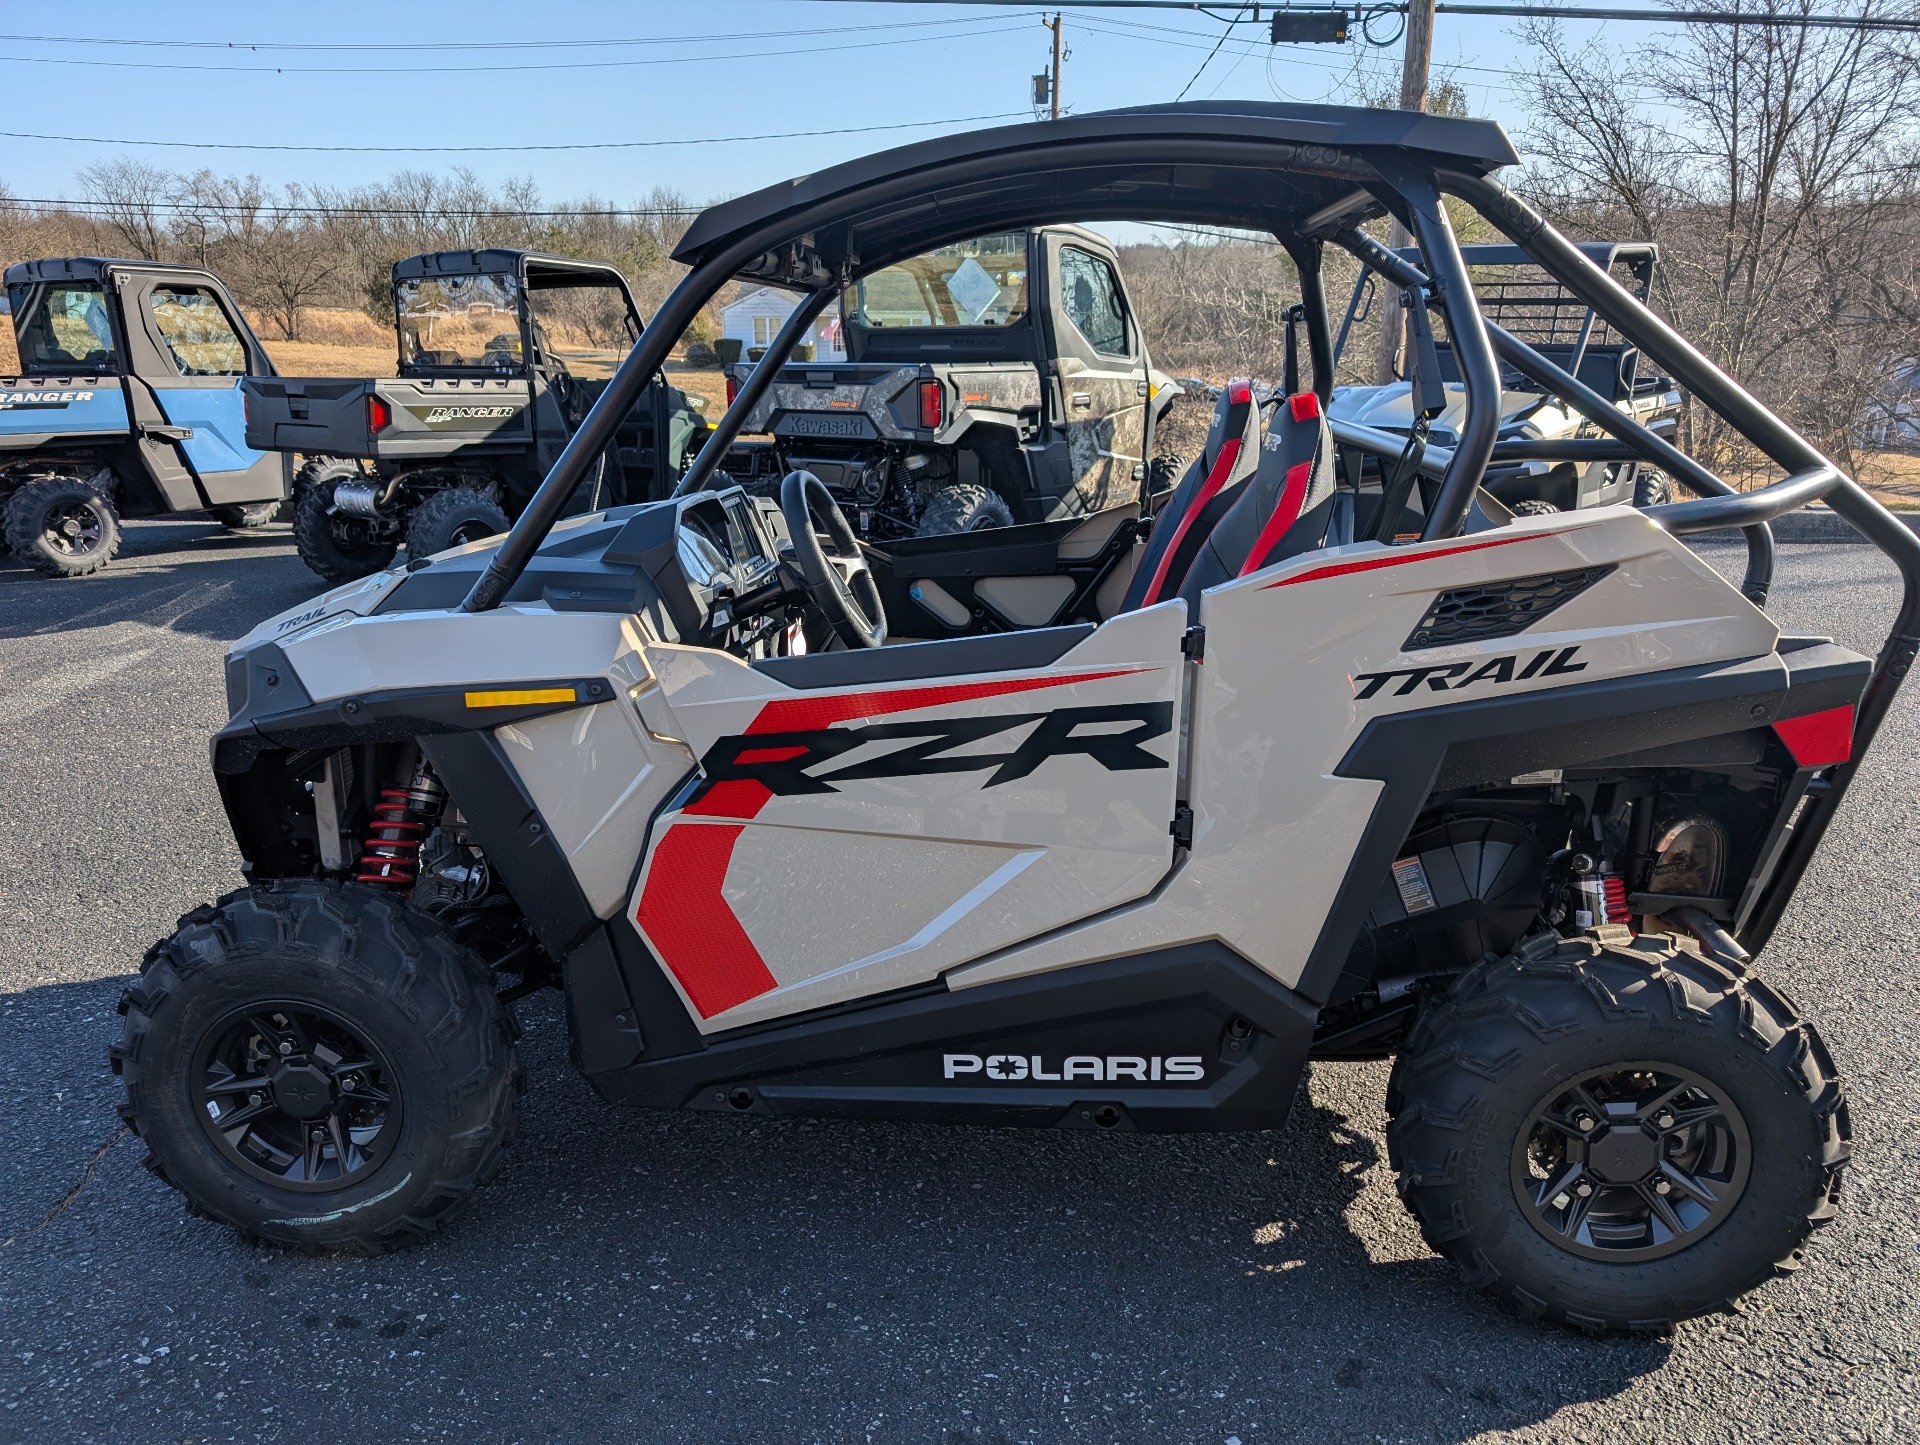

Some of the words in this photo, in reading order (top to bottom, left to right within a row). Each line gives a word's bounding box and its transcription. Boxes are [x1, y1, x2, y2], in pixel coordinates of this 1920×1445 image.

[963, 383, 1001, 391] RIDGE
[430, 407, 514, 417] RANGER
[789, 416, 863, 435] Kawasaki
[277, 607, 327, 632] TRAIL
[1353, 645, 1590, 700] TRAIL
[682, 701, 1175, 805] RZR
[943, 1053, 1205, 1081] POLARIS
